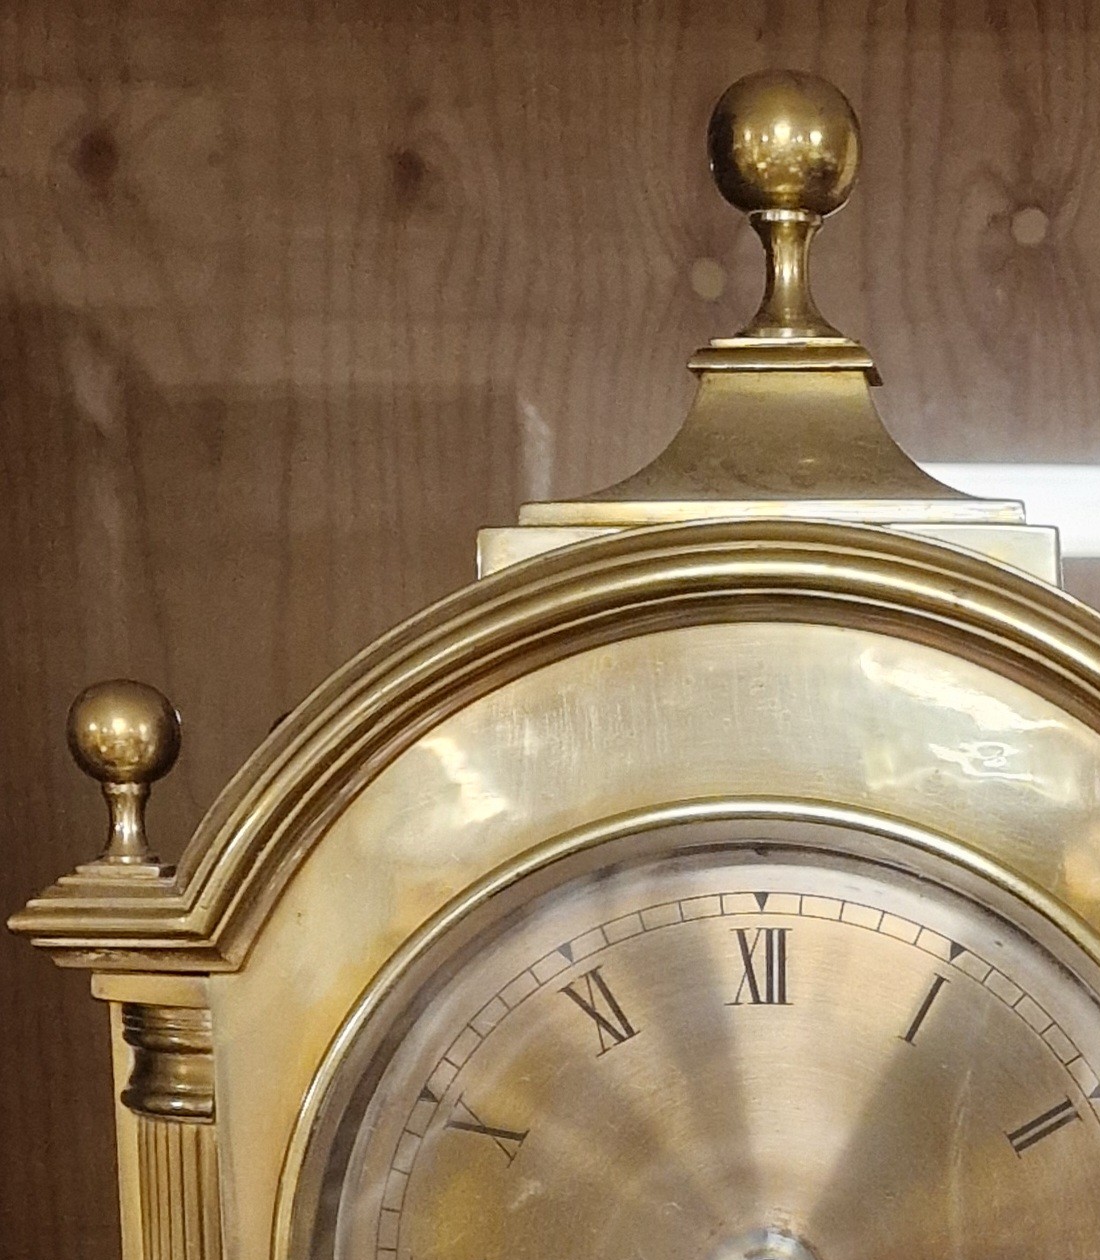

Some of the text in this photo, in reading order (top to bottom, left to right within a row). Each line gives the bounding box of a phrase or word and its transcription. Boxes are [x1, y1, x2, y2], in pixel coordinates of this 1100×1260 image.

[724, 927, 794, 1006] XII
[557, 965, 641, 1057] XI
[897, 973, 951, 1047] I
[443, 1089, 531, 1169] X
[1004, 1095, 1083, 1160] II
